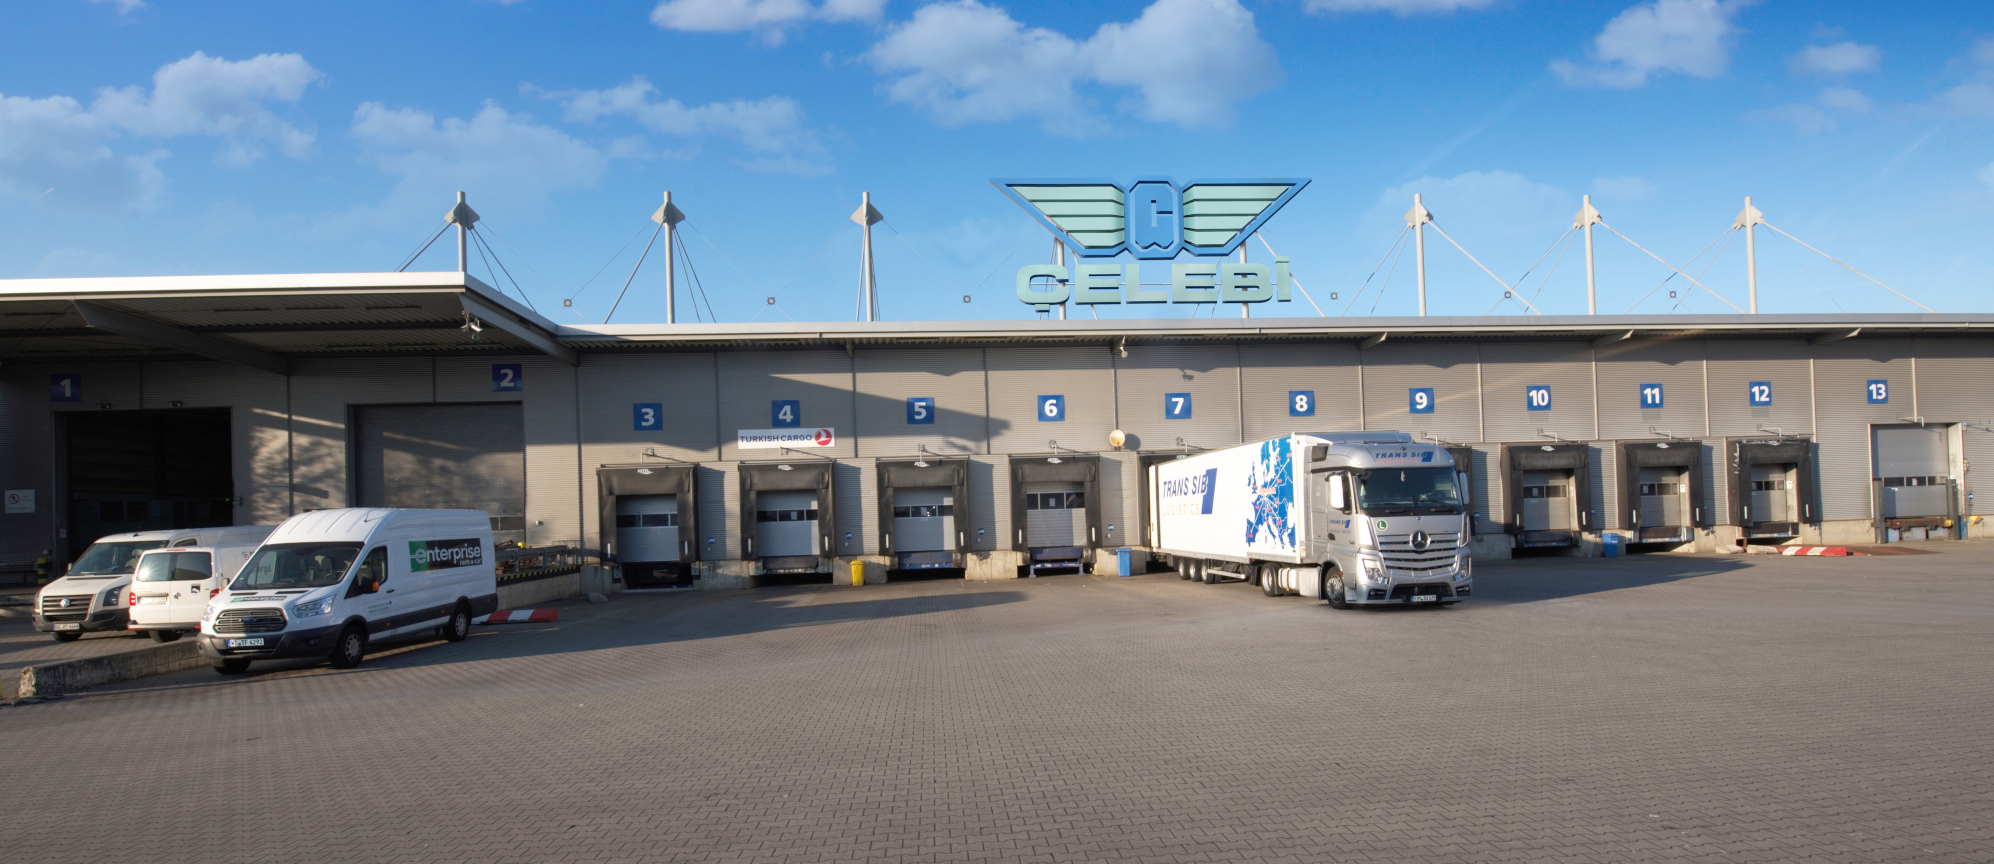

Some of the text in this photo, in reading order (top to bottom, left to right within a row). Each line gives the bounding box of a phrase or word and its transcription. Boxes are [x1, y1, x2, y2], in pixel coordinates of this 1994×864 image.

[1016, 256, 1292, 313] ÇELEBİ
[500, 369, 514, 387] 2
[60, 379, 72, 397] 1
[1643, 388, 1660, 404] 11
[1751, 385, 1770, 402] 12
[1868, 383, 1886, 400] 13
[1171, 397, 1185, 415] 7
[1295, 396, 1308, 414] 8
[1415, 392, 1428, 409] 9
[1528, 389, 1549, 406] 10
[778, 405, 794, 423] 4
[914, 402, 927, 421] 5
[1044, 399, 1058, 417] 6
[641, 408, 655, 427] 3
[780, 434, 812, 442] CARGO
[1375, 451, 1408, 459] TRANS
[1163, 474, 1209, 498] TRANS SIB
[1163, 503, 1200, 516] LOGISTICS
[412, 543, 481, 564] enterprise
[459, 558, 482, 566] rent-a-car
